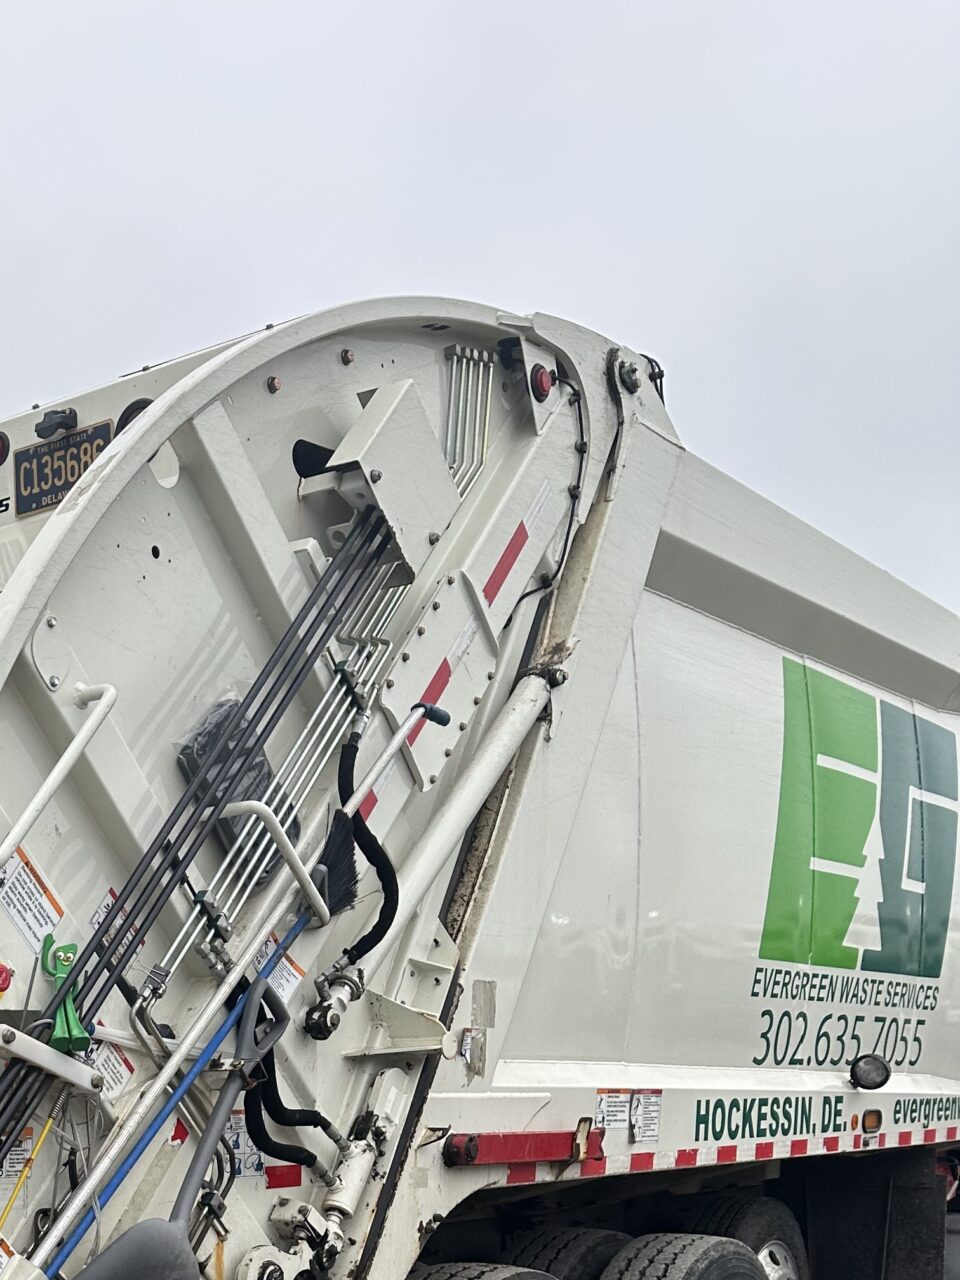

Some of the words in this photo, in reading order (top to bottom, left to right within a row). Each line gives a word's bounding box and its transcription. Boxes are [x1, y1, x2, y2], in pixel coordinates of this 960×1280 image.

[41, 490, 69, 506] DELA
[751, 967, 839, 1003] EVERGREEN
[840, 975, 885, 1007] WASTE
[884, 981, 940, 1011] SERVICES
[752, 1009, 927, 1067] 302.6357055
[694, 1096, 816, 1142] HOCKESSIN,
[820, 1095, 848, 1134] DE.
